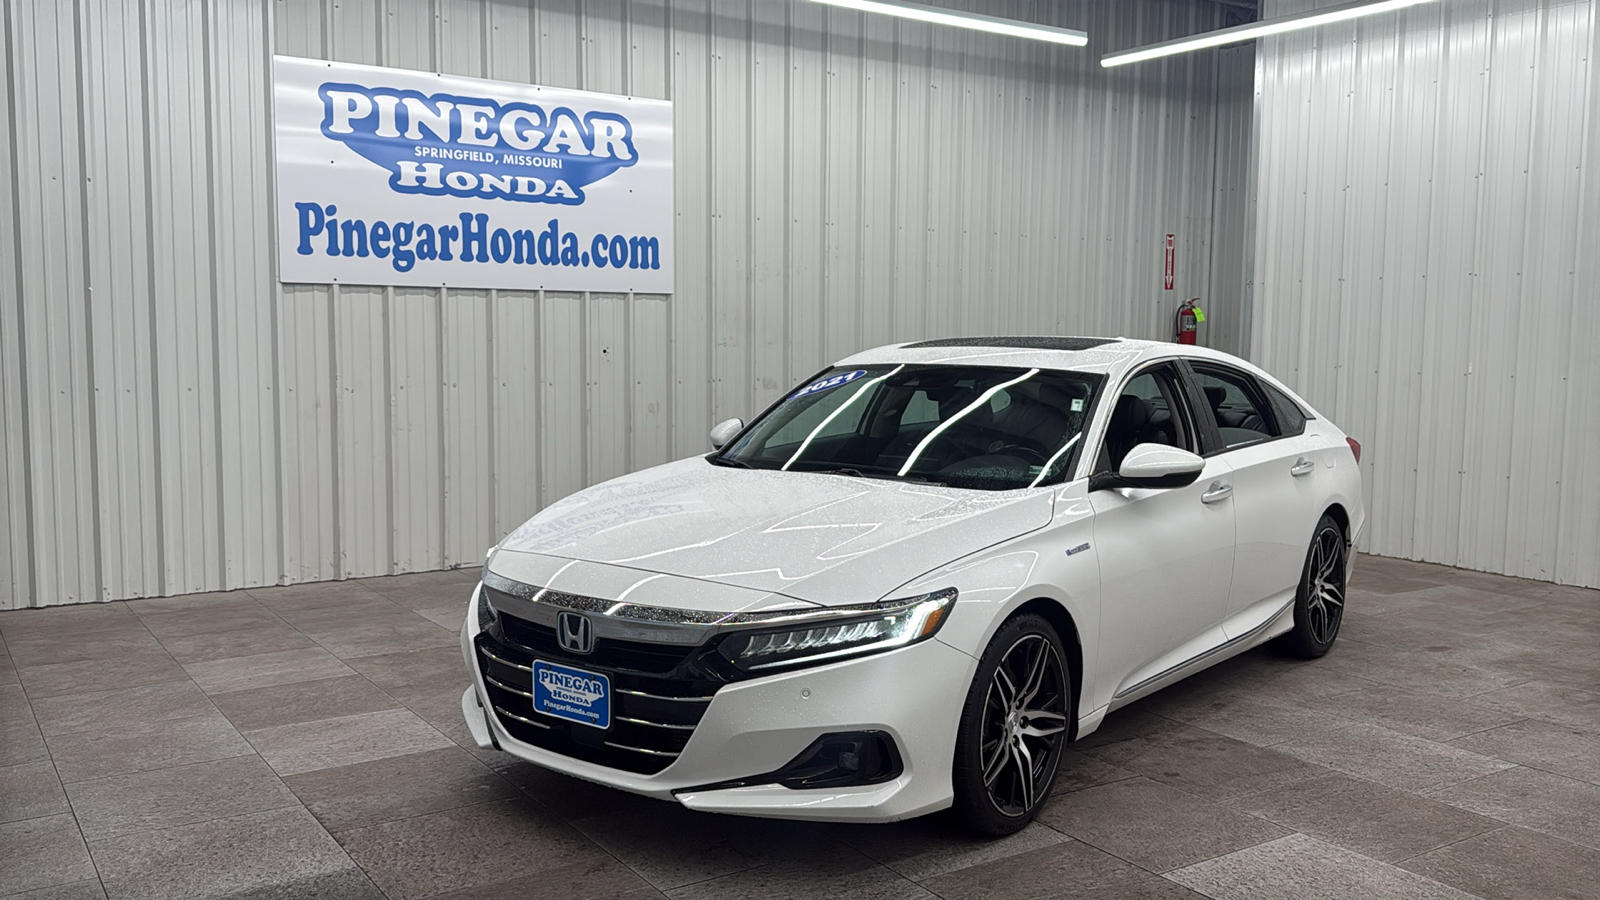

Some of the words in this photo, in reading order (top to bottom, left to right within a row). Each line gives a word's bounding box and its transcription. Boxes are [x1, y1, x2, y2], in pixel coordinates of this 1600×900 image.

[326, 90, 633, 161] PINEGAR
[414, 145, 499, 165] SPRINGFIELD,
[502, 153, 563, 169] MISSOURI
[396, 160, 579, 199] HONDA
[295, 202, 661, 272] PinegarHonda.com
[793, 371, 858, 398] 2021
[540, 671, 603, 696] PINEGAR
[543, 699, 600, 719] PinegarHonda.com
[552, 690, 590, 705] HONDA
